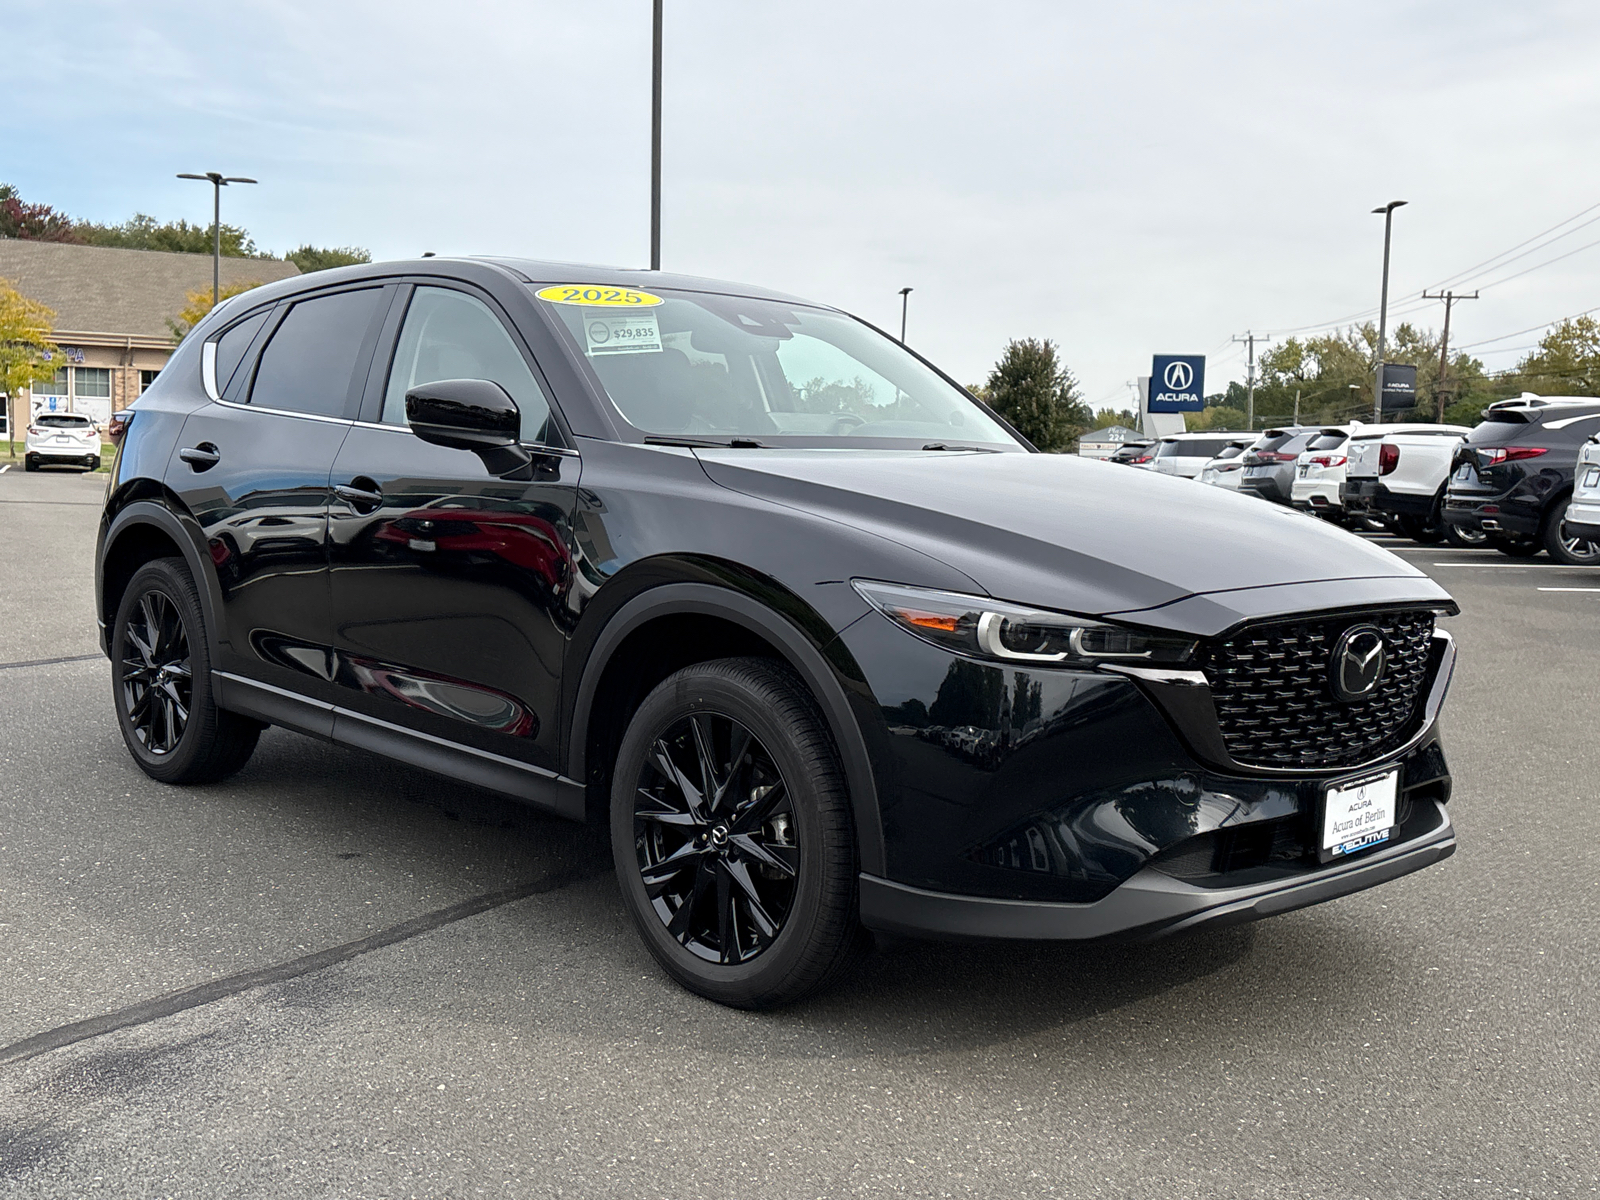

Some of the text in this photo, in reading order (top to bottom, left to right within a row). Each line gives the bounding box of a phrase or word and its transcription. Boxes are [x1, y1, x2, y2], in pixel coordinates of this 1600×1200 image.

[562, 288, 642, 304] 2025
[613, 327, 654, 339] $29,835
[1155, 392, 1199, 402] ACURA
[1108, 434, 1125, 442] 224
[1348, 799, 1372, 812] ACURA
[1332, 808, 1385, 834] Acura of Berlin
[1332, 828, 1389, 855] EXECUTIVE
